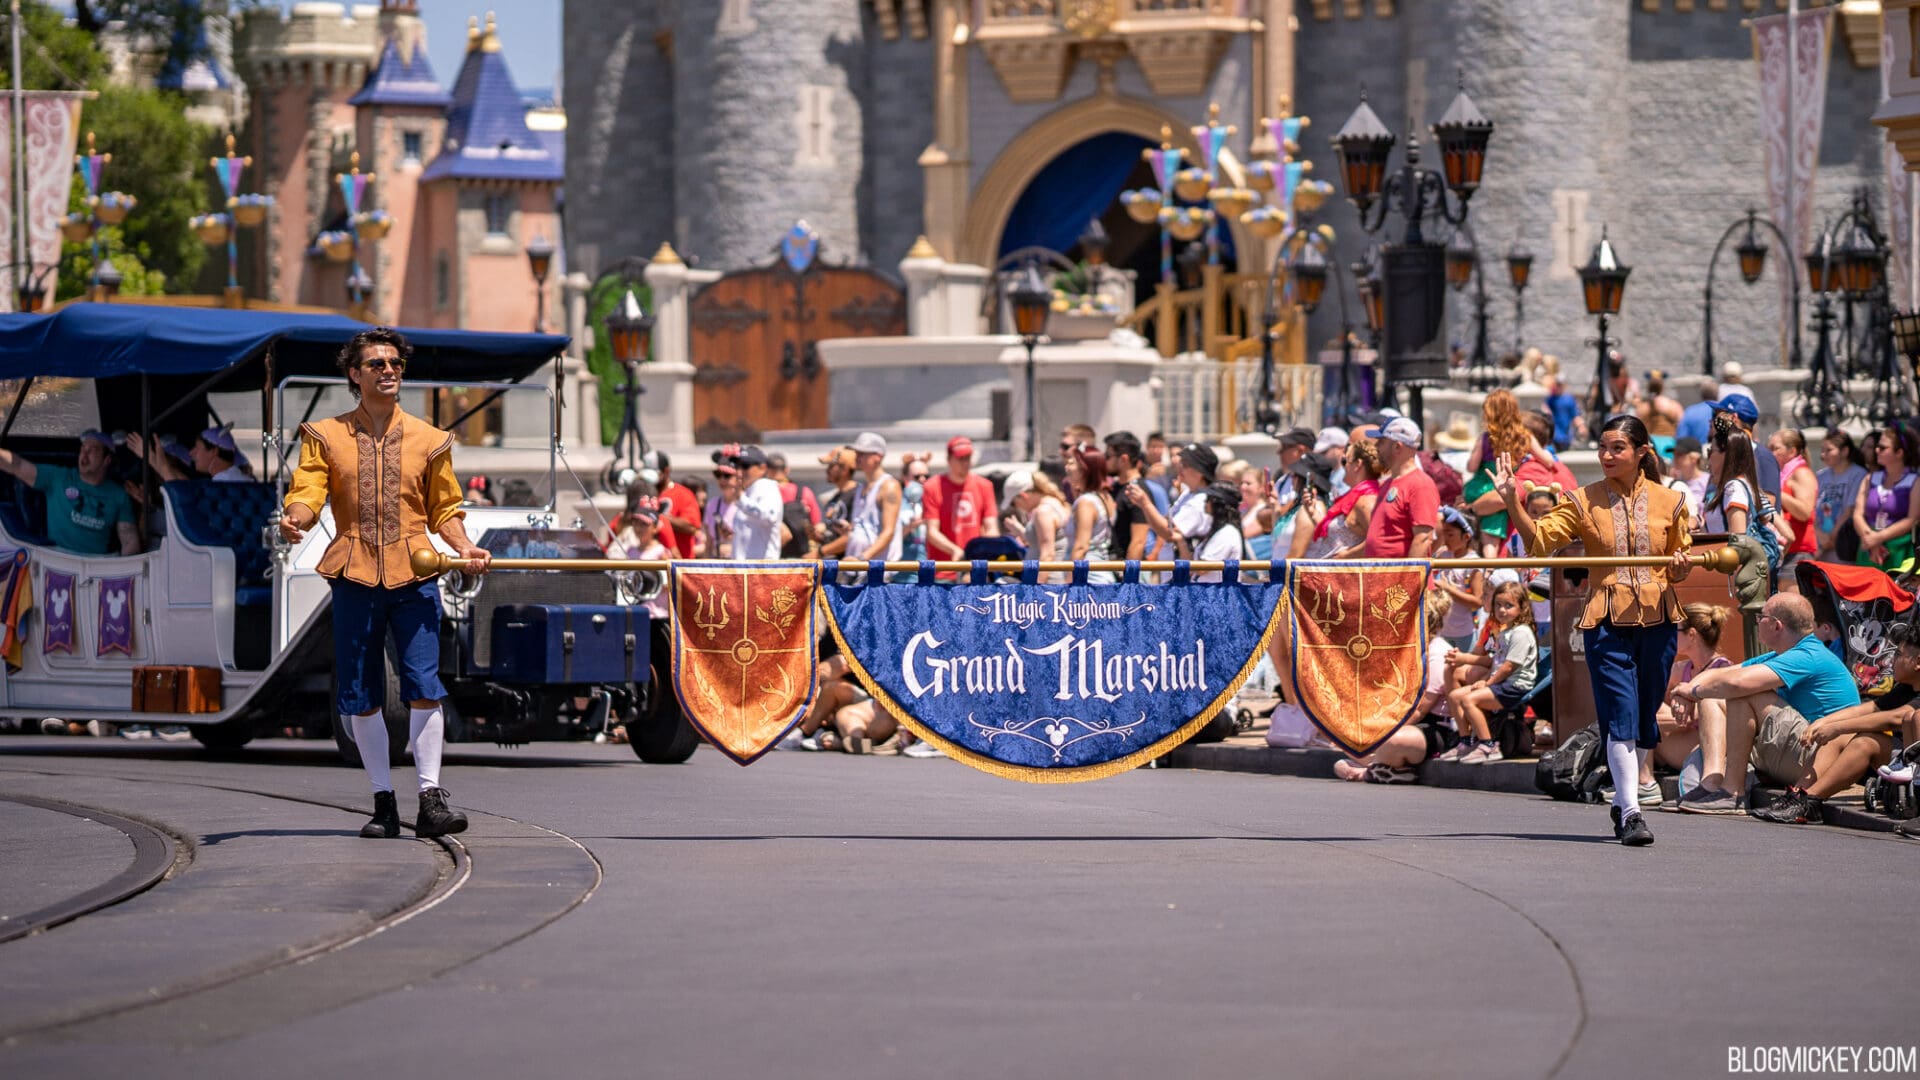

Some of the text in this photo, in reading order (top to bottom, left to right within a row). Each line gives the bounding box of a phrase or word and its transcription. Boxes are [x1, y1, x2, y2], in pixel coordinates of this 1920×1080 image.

[978, 591, 1121, 629] Magic Kingdom
[902, 630, 1208, 703] Grand Marshal
